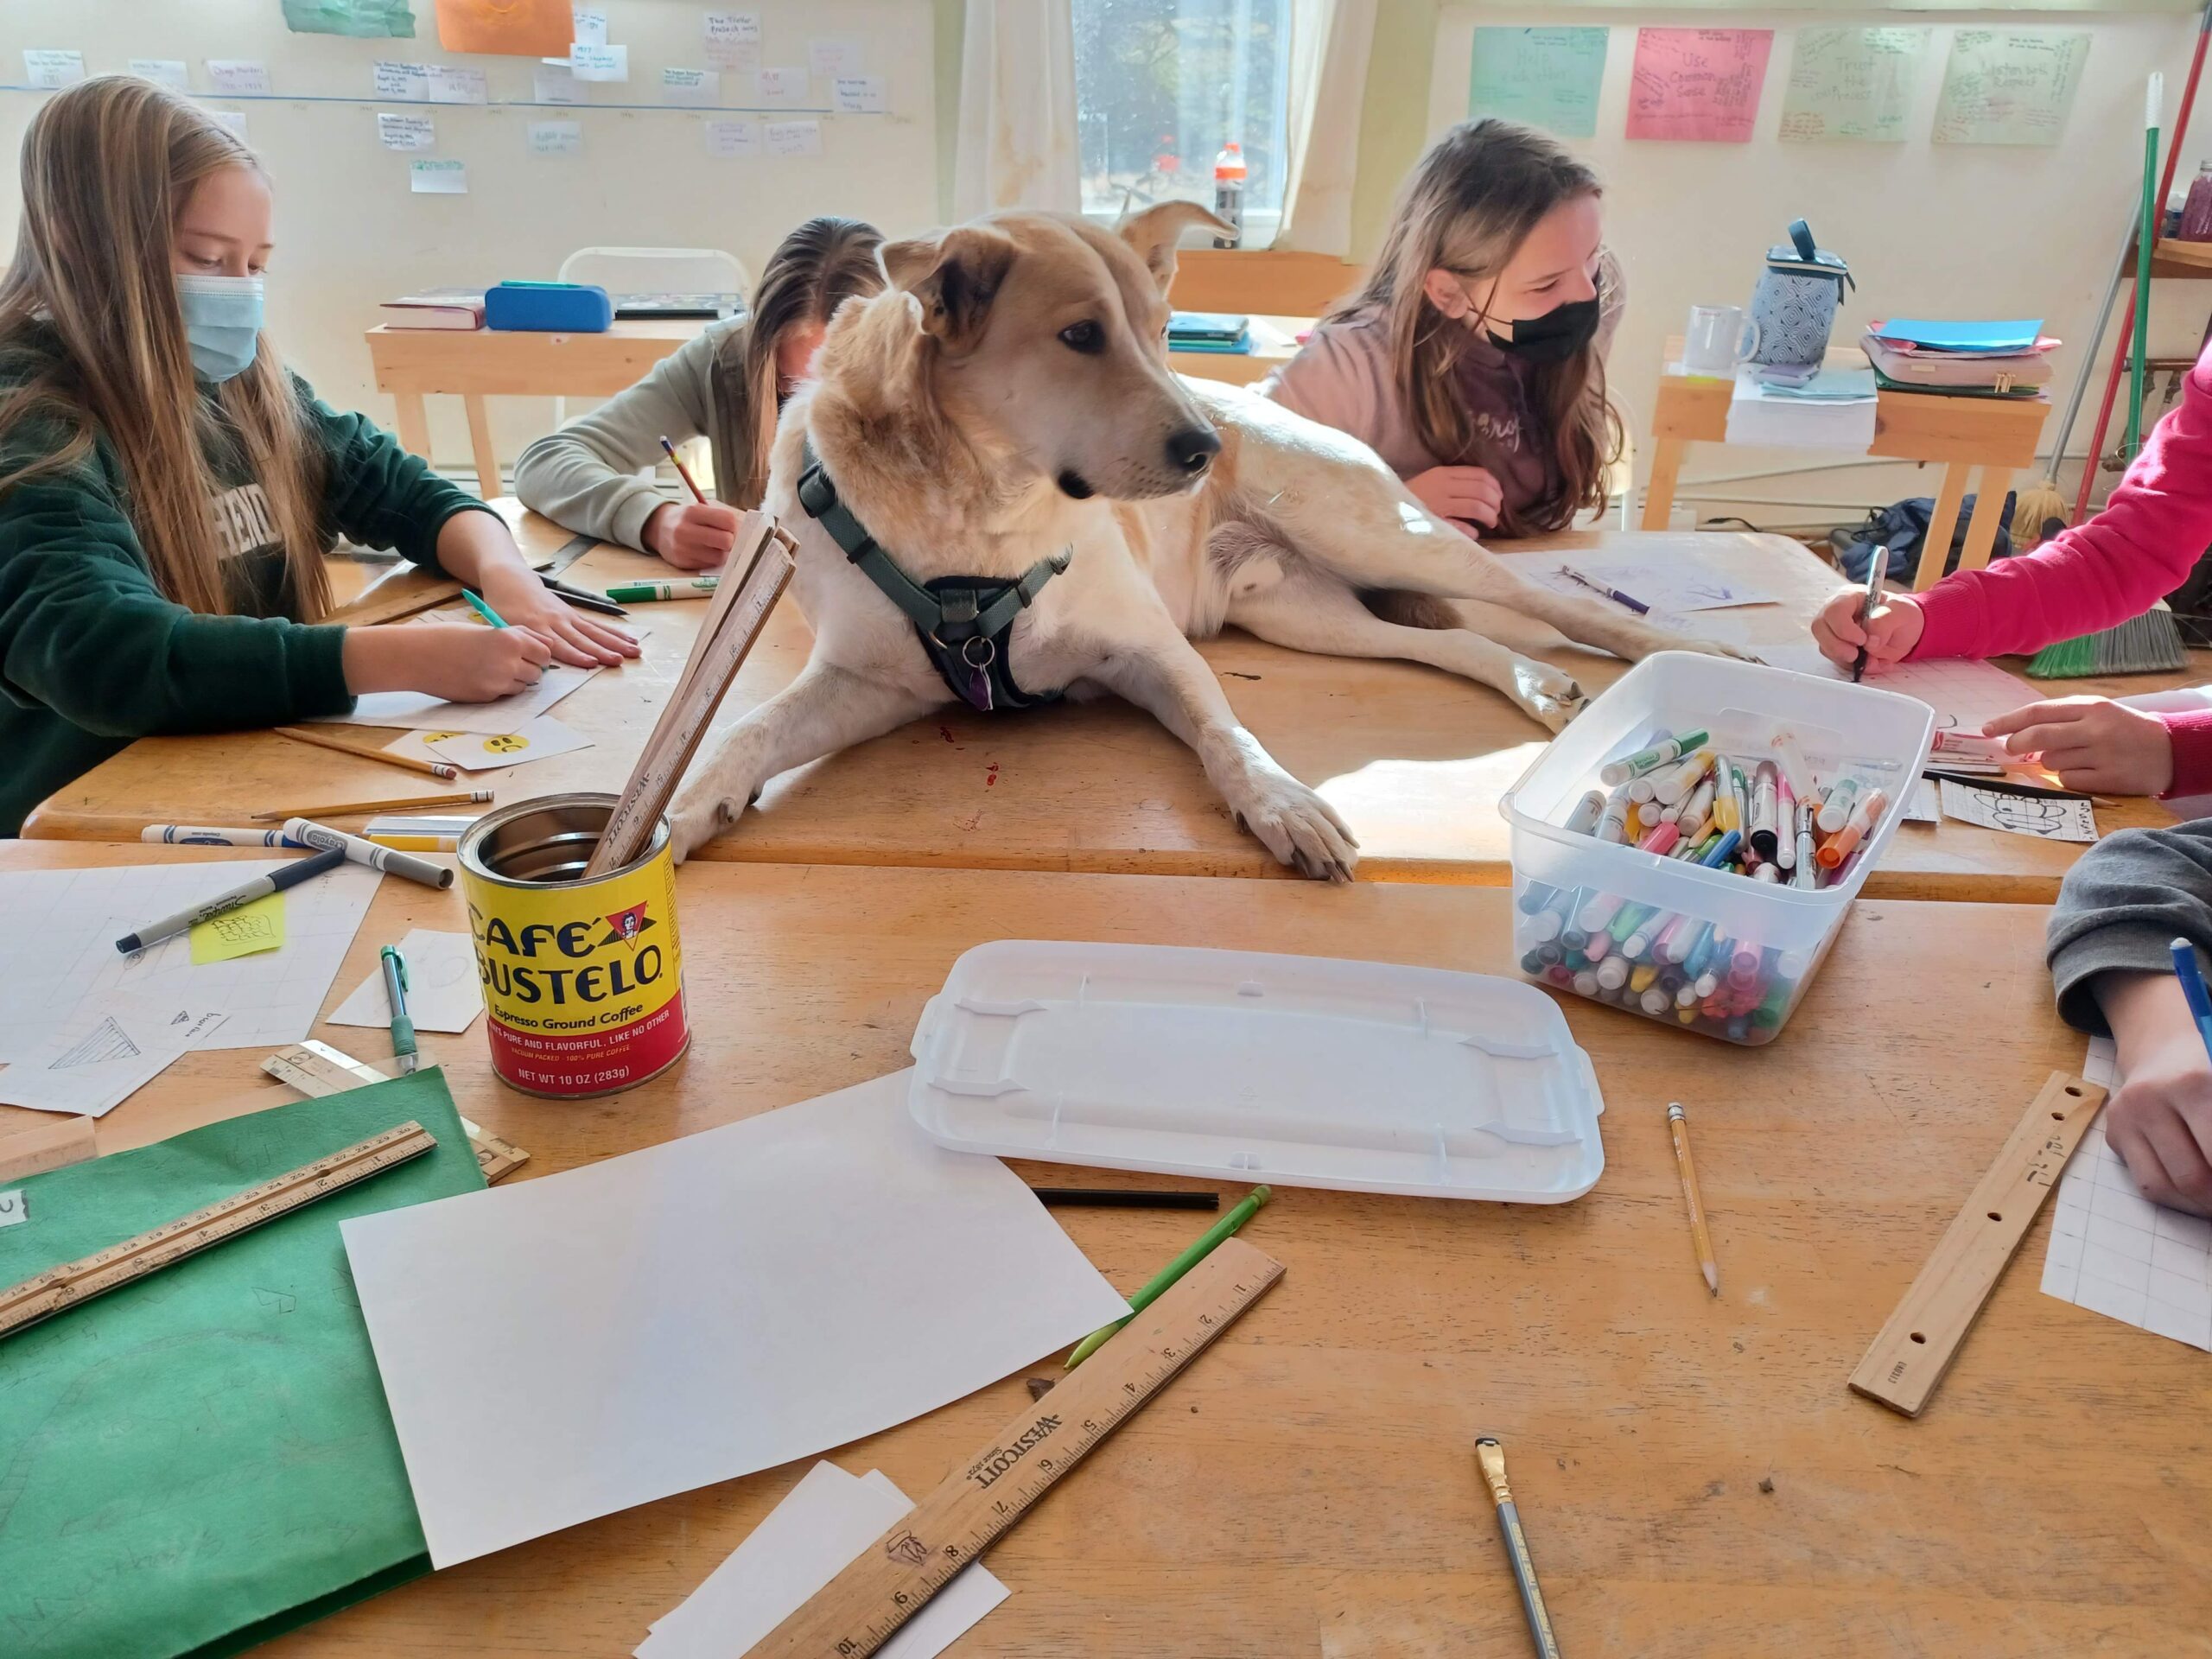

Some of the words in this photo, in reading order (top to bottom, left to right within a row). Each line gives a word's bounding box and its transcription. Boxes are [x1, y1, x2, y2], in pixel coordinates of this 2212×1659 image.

[1683, 53, 1708, 67] Use
[494, 1004, 538, 1028] Espresso
[543, 1015, 595, 1029] Ground
[600, 1003, 643, 1023] Coffee
[503, 1031, 523, 1046] PURE
[524, 1039, 543, 1050] AND
[609, 1031, 630, 1045] LIKE
[632, 1025, 645, 1037] NO
[646, 1009, 670, 1030] OTHER
[512, 1046, 534, 1058] VACUUM
[586, 1051, 604, 1059] PURE
[606, 1044, 630, 1056] COFFEE
[518, 1068, 535, 1081] NET
[538, 1073, 555, 1084] WT
[558, 1076, 572, 1084] 10
[575, 1074, 590, 1084] OZ
[594, 1065, 630, 1084] (283g)
[1236, 1284, 1247, 1293] 1
[1199, 1314, 1212, 1325] 2
[1163, 1348, 1176, 1358] 3
[1124, 1382, 1136, 1393] 4
[1084, 1420, 1097, 1432] 5
[975, 1414, 1063, 1490] WESTCOTT
[983, 1446, 1002, 1464] Since
[1041, 1459, 1053, 1471] 6
[996, 1501, 1008, 1513] 7
[945, 1545, 959, 1557] 8
[894, 1591, 908, 1605] 9
[838, 1637, 857, 1655] 10
